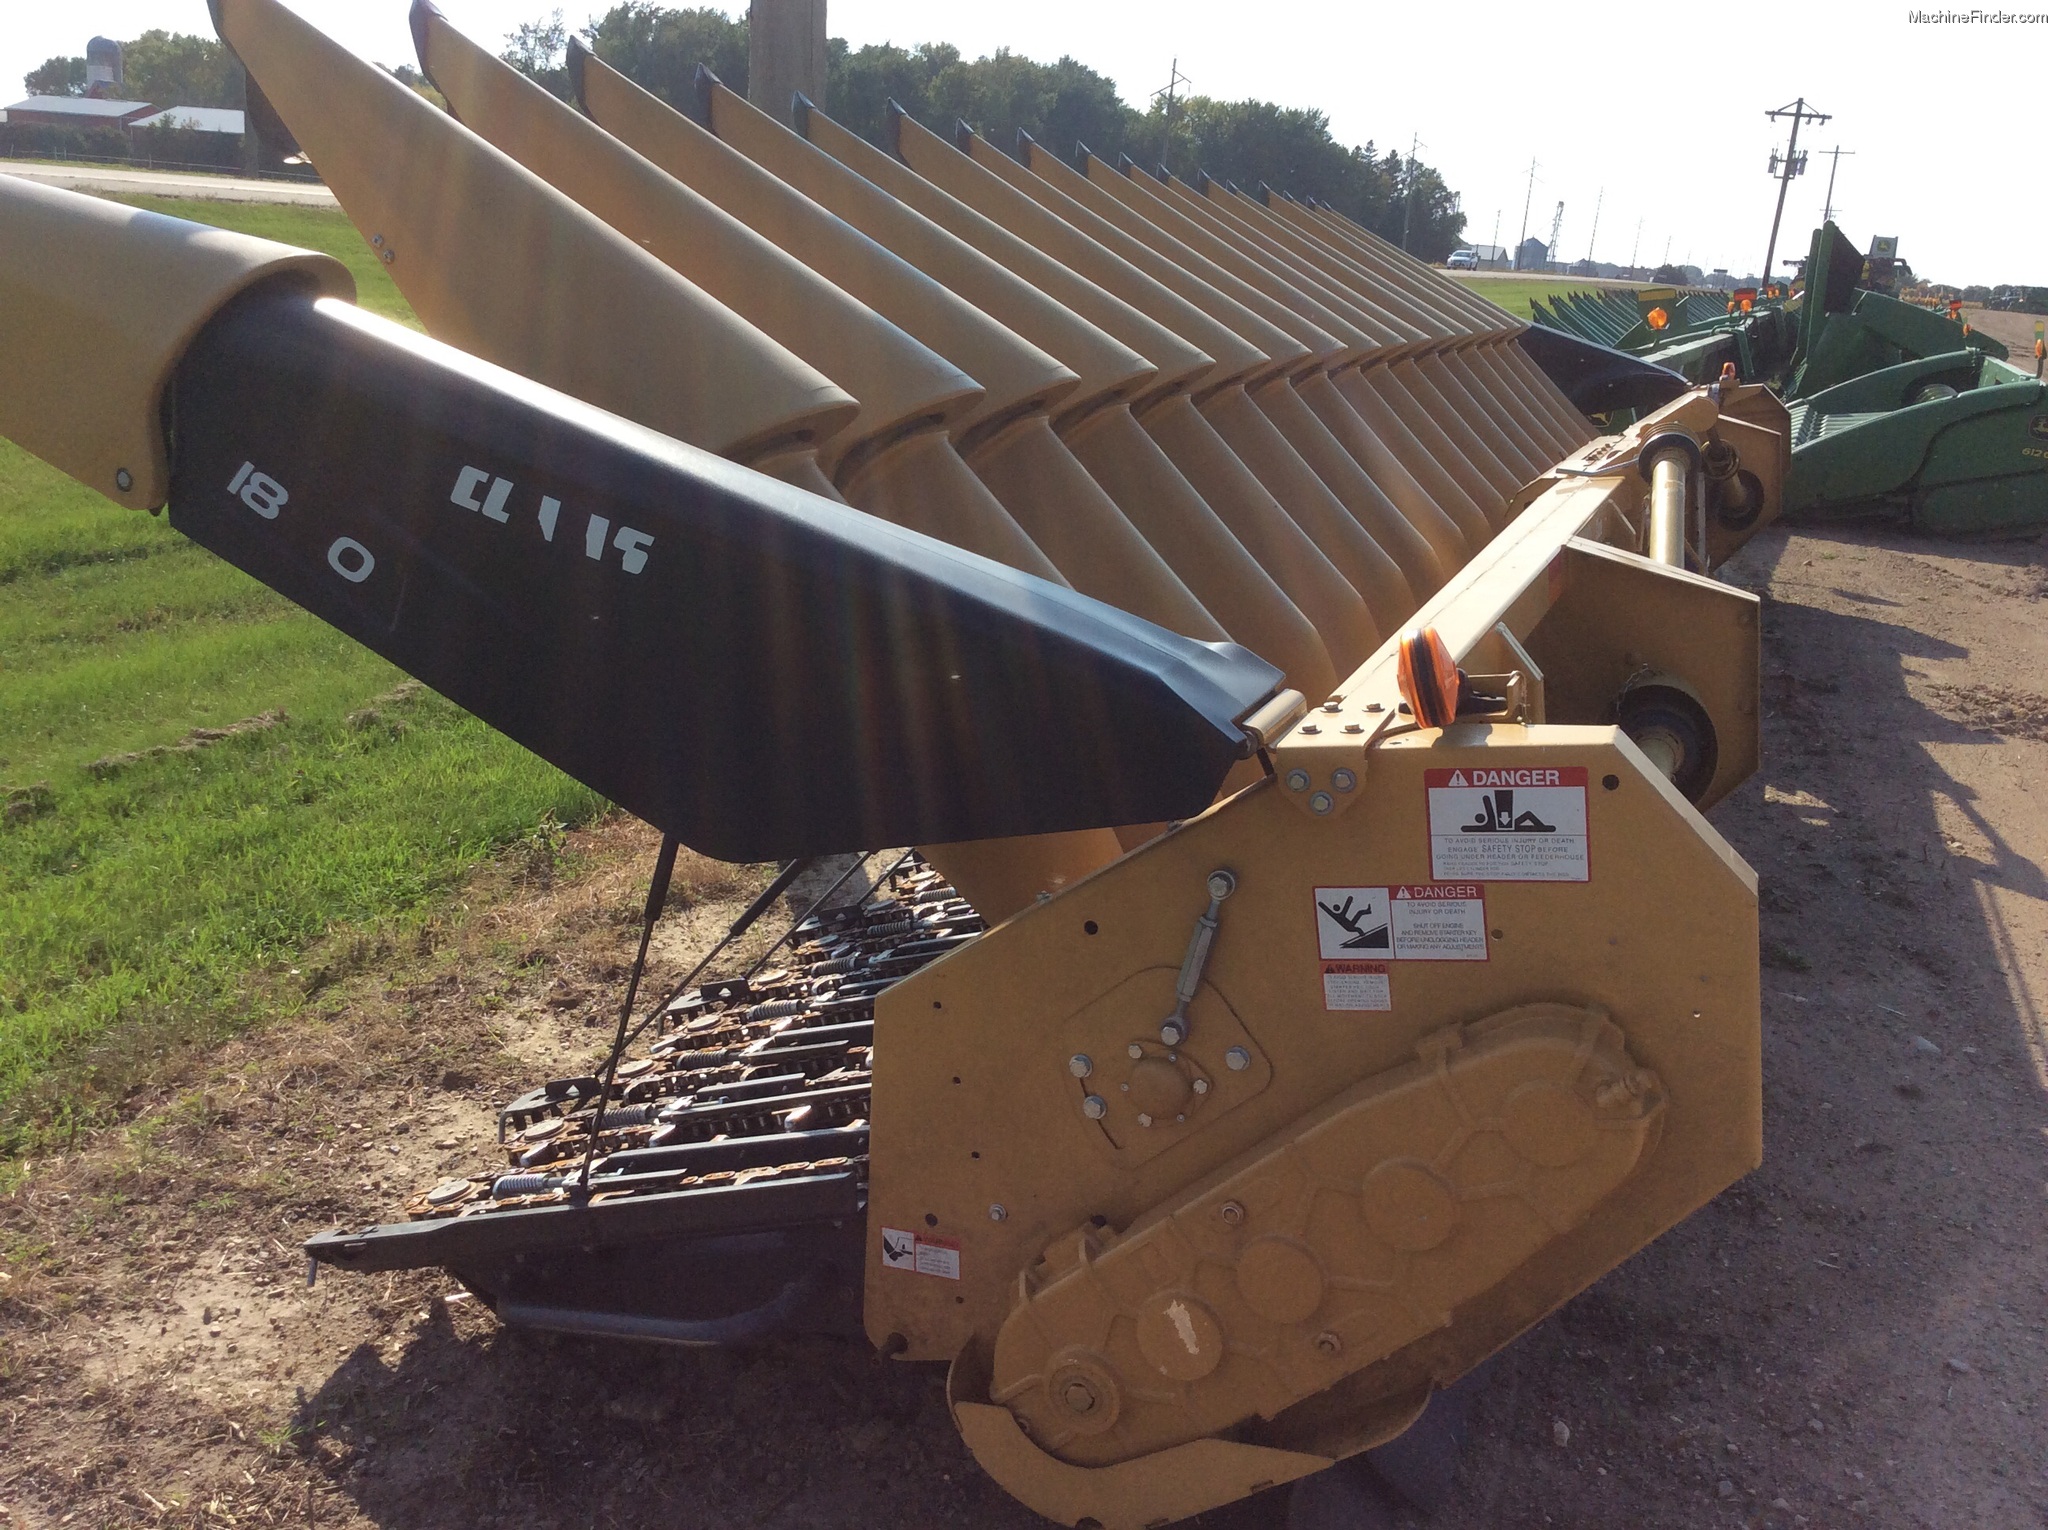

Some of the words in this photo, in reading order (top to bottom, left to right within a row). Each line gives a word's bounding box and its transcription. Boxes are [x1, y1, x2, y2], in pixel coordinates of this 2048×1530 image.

[1473, 770, 1560, 786] DANGER
[1482, 844, 1512, 853] SAFETY
[1515, 844, 1536, 853] STOP
[1414, 886, 1477, 898] DANGER
[1335, 964, 1386, 974] WARNING
